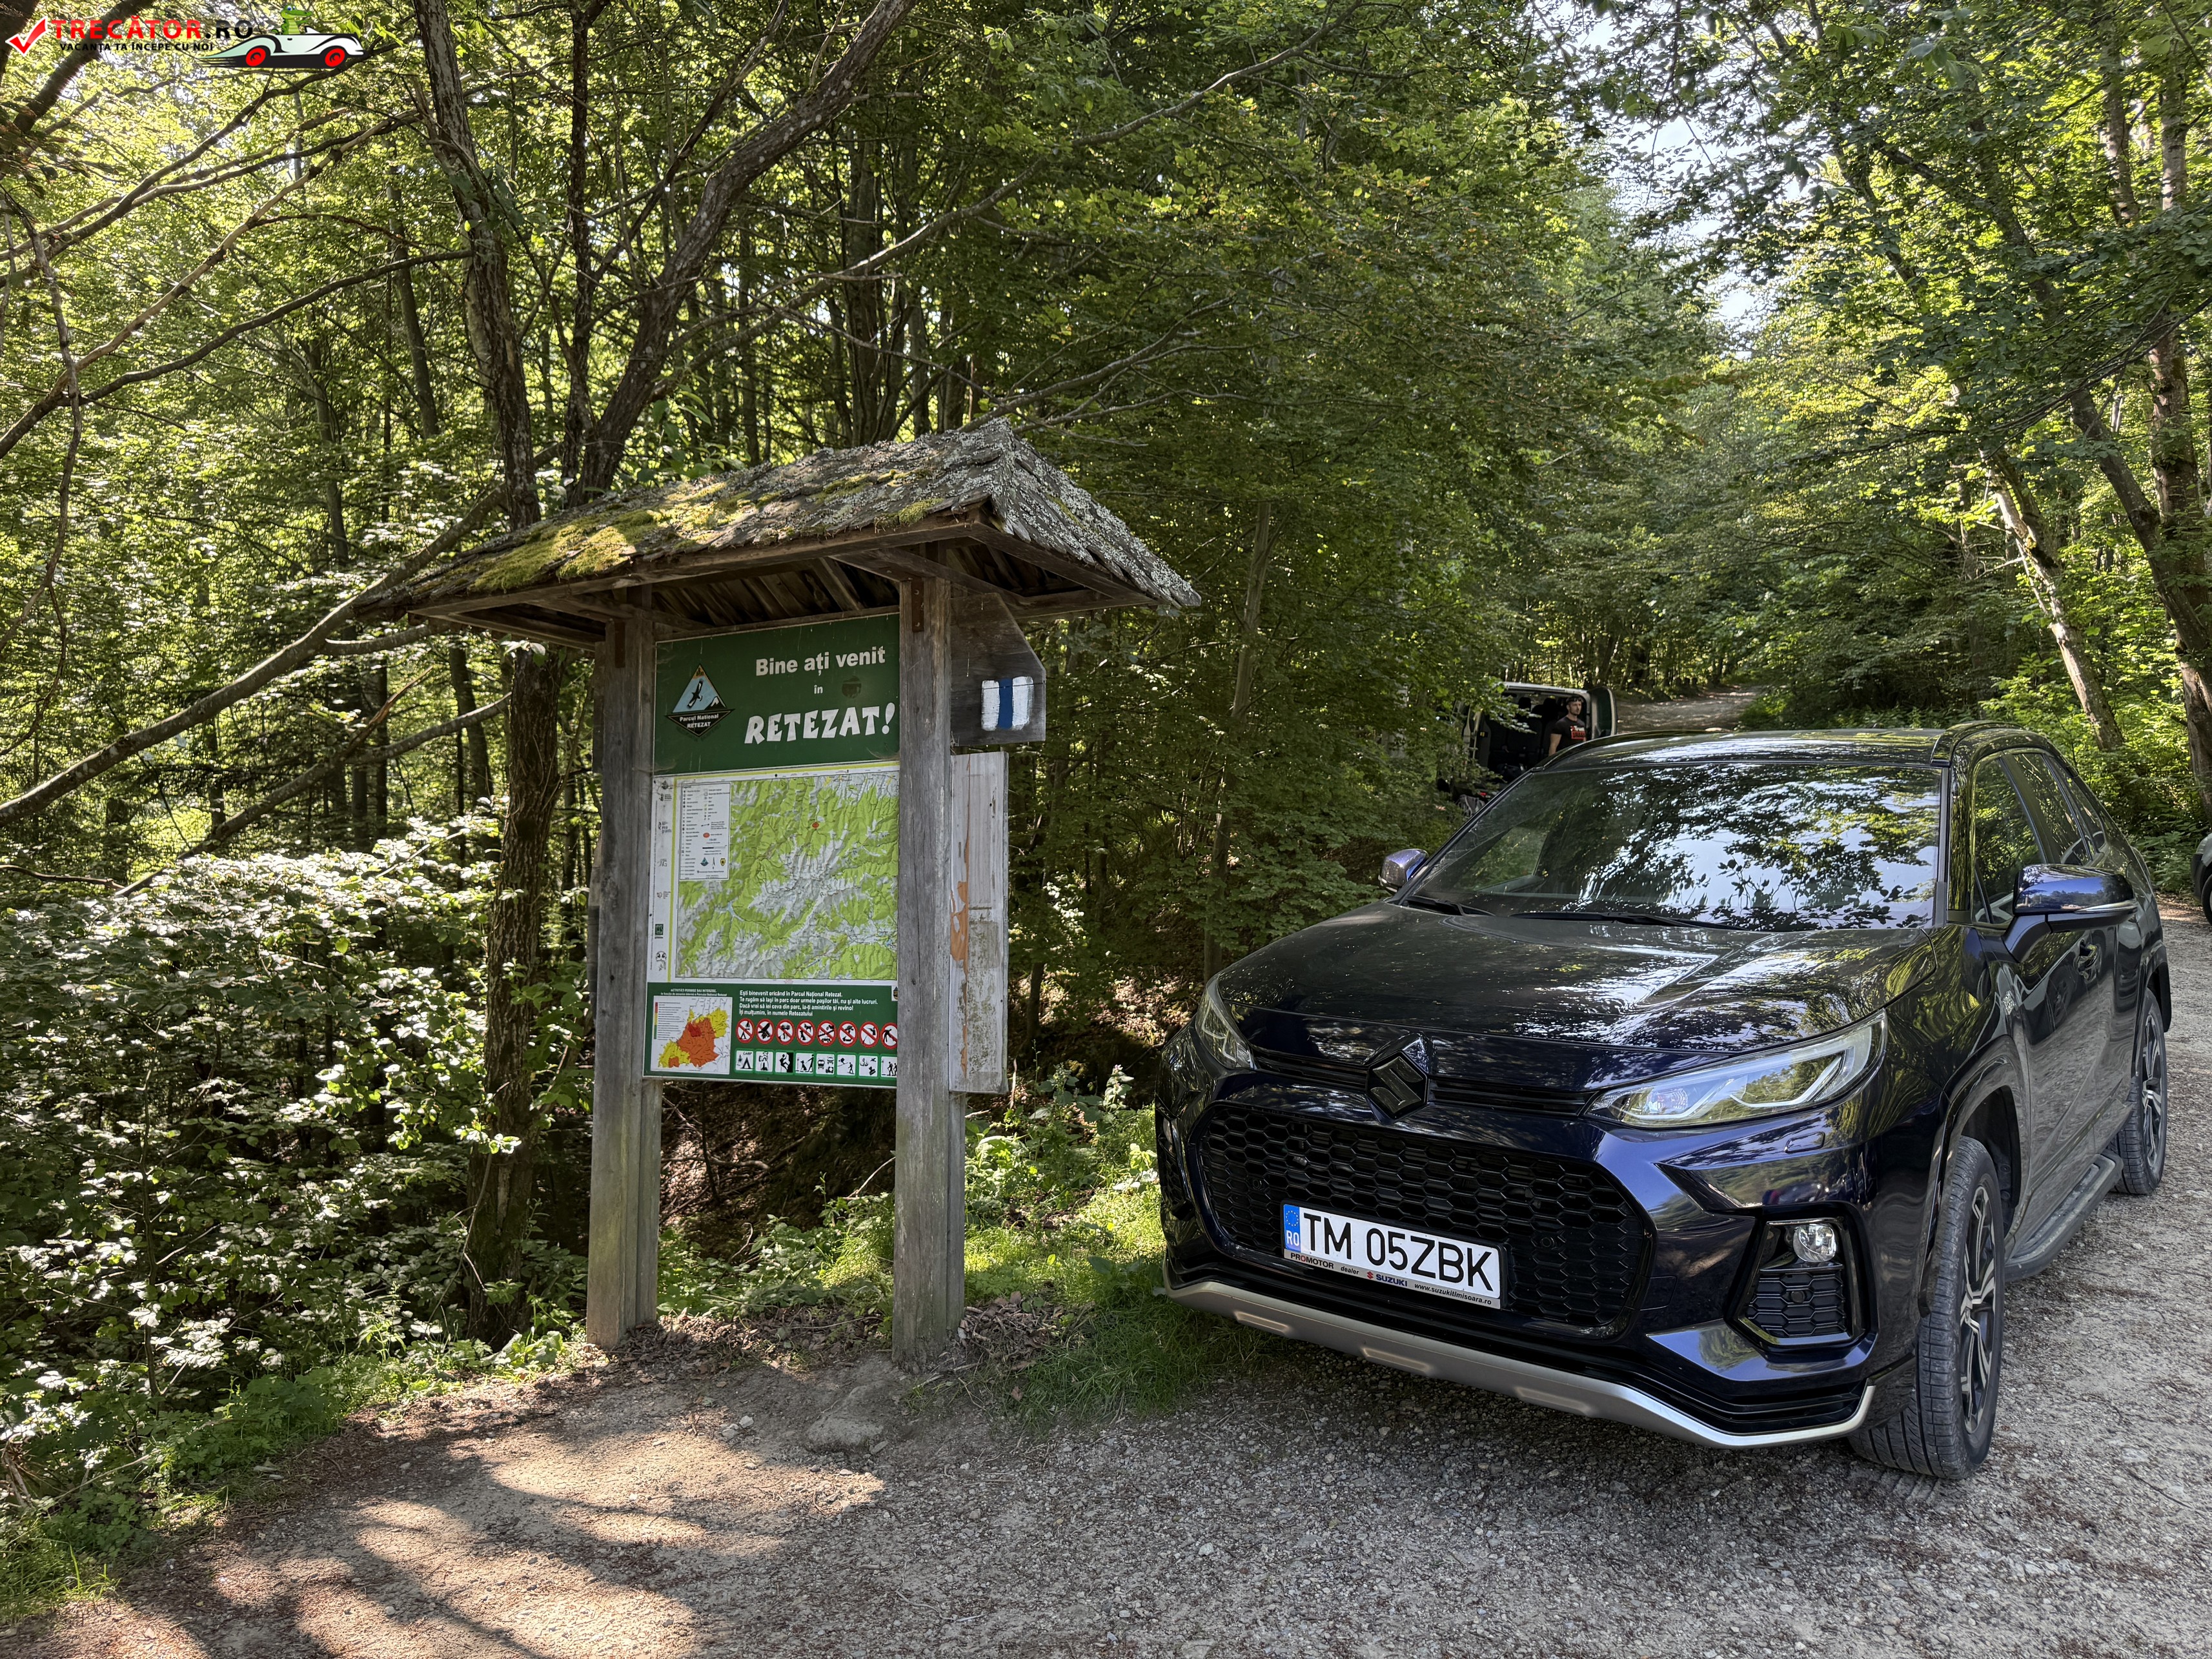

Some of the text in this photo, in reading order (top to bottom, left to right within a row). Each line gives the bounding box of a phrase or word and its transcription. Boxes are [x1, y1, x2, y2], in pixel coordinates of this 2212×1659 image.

[756, 646, 886, 676] Bine ați venit
[814, 684, 823, 694] în
[744, 702, 895, 744] RETEZAT!
[1286, 1230, 1300, 1247] RO
[1303, 1213, 1494, 1292] TM 05ZBK
[1291, 1252, 1492, 1305] PROMOTOR dealer SUZUKI www.suzukitimisoara.ro
